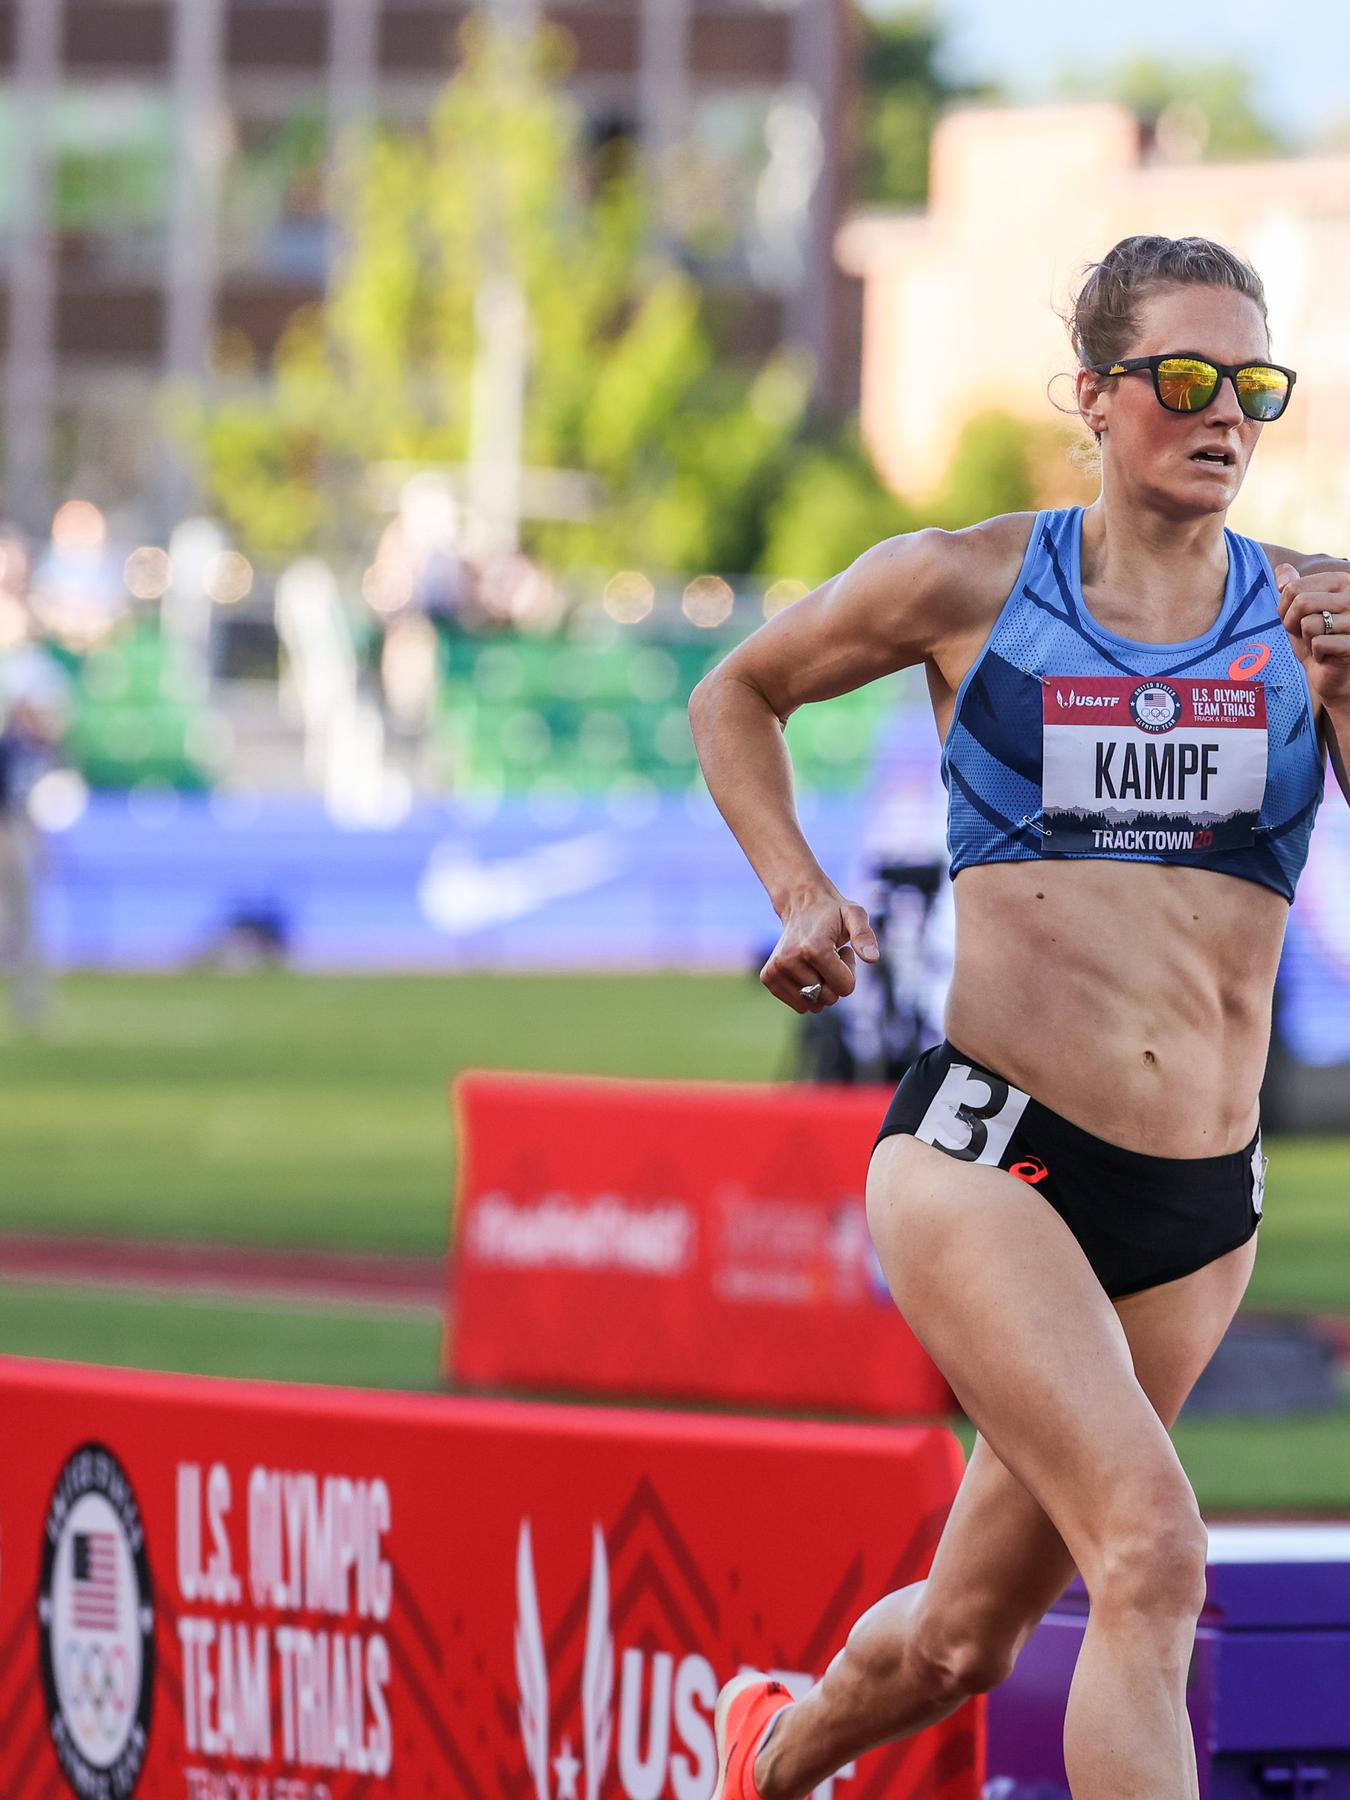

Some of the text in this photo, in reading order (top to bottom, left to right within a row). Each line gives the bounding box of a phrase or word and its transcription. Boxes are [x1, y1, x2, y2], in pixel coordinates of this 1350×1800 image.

[1134, 682, 1177, 698] UNITED STATES
[1192, 688, 1256, 704] U.S. OLYMPIC
[1075, 695, 1120, 707] USATF
[1192, 702, 1256, 718] TEAM TRIALS
[1135, 718, 1177, 732] OLYMPIC TEAM
[1194, 715, 1214, 723] TRACK
[1095, 742, 1219, 801] KAMPF
[932, 1066, 1009, 1161] 3
[177, 1462, 241, 1602] U.S.
[247, 1464, 391, 1622] OLYMPIC
[177, 1616, 272, 1758] TEAM
[276, 1623, 391, 1779] TRIALS
